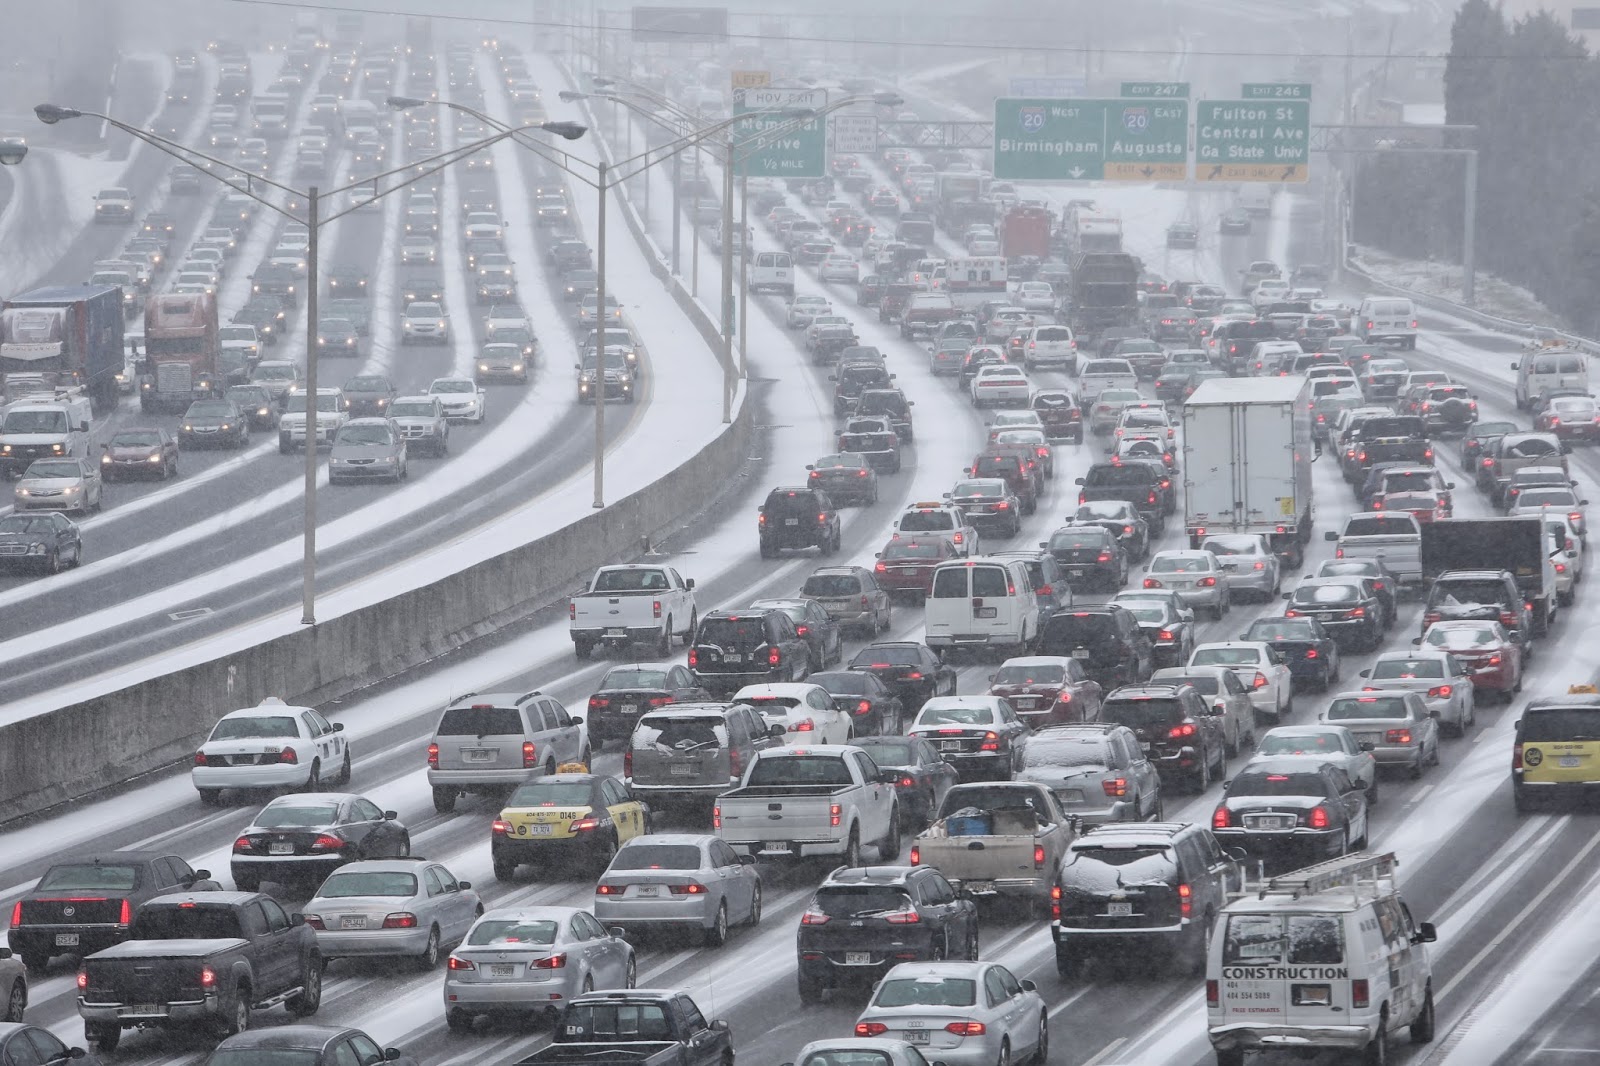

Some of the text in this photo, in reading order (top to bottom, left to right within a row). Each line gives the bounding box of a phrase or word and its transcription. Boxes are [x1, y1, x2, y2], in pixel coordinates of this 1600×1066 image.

[736, 75, 766, 85] LEFT
[1154, 85, 1179, 95] 247
[1275, 87, 1300, 96] 246
[756, 93, 815, 103] HOV EXIT
[1213, 107, 1294, 120] Fulton St
[741, 118, 818, 131] Memal
[1024, 114, 1042, 126] 20
[1127, 115, 1146, 127] 20
[1201, 126, 1304, 139] Central Ave
[1000, 139, 1098, 155] Birmingham
[1112, 141, 1182, 156] Augusta
[1201, 145, 1303, 158] Ga State Univ
[782, 160, 805, 169] MILE
[1228, 168, 1275, 177] EXIT ONLY
[1223, 967, 1348, 979] CONSTRUCTION
[1227, 981, 1238, 989] 404
